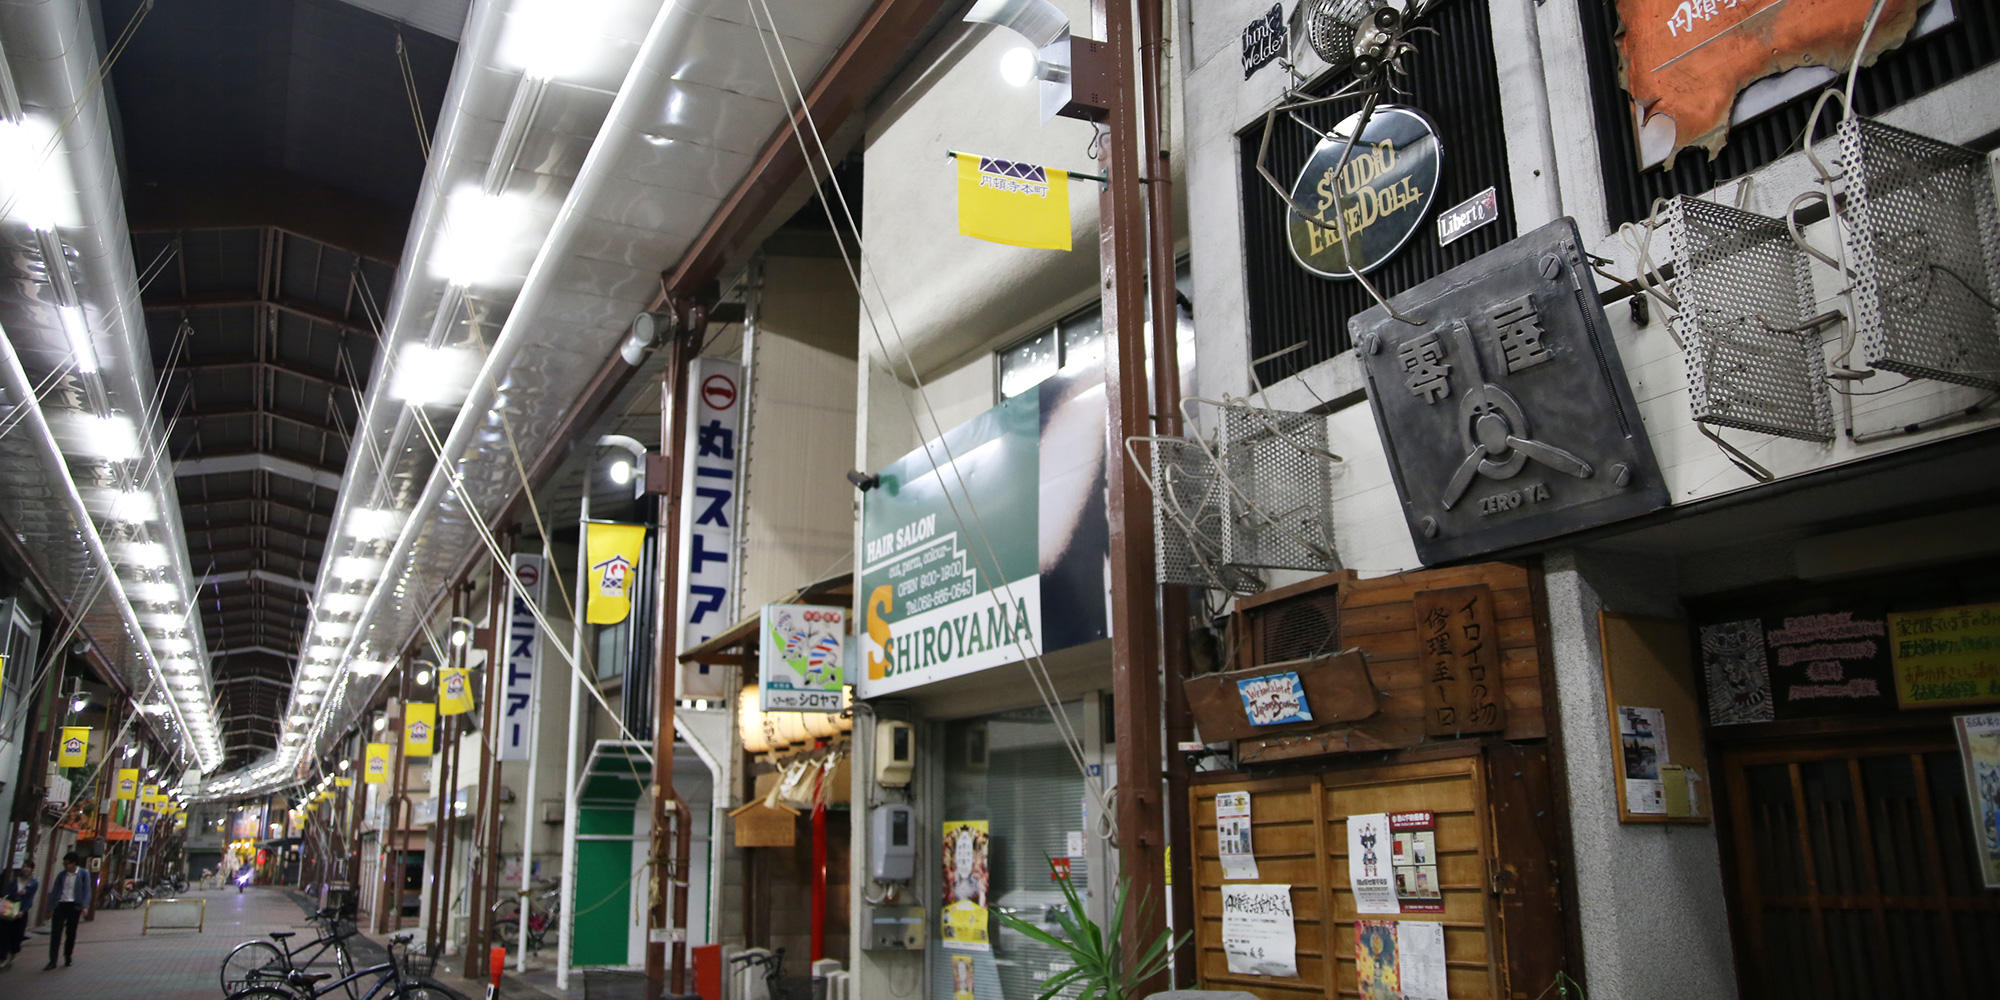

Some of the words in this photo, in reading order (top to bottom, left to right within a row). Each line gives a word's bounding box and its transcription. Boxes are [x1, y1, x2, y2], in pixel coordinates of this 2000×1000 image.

[979, 176, 1050, 196] 円頓寺本町
[1317, 138, 1396, 211] STUDIO
[1478, 493, 1522, 517] ZERO
[1522, 481, 1551, 504] YA
[866, 533, 894, 564] HAIR
[896, 513, 936, 551] SALON
[897, 577, 919, 598] OPEN
[884, 597, 1033, 678] SHIROYAMA
[799, 693, 840, 708] シロヤマ
